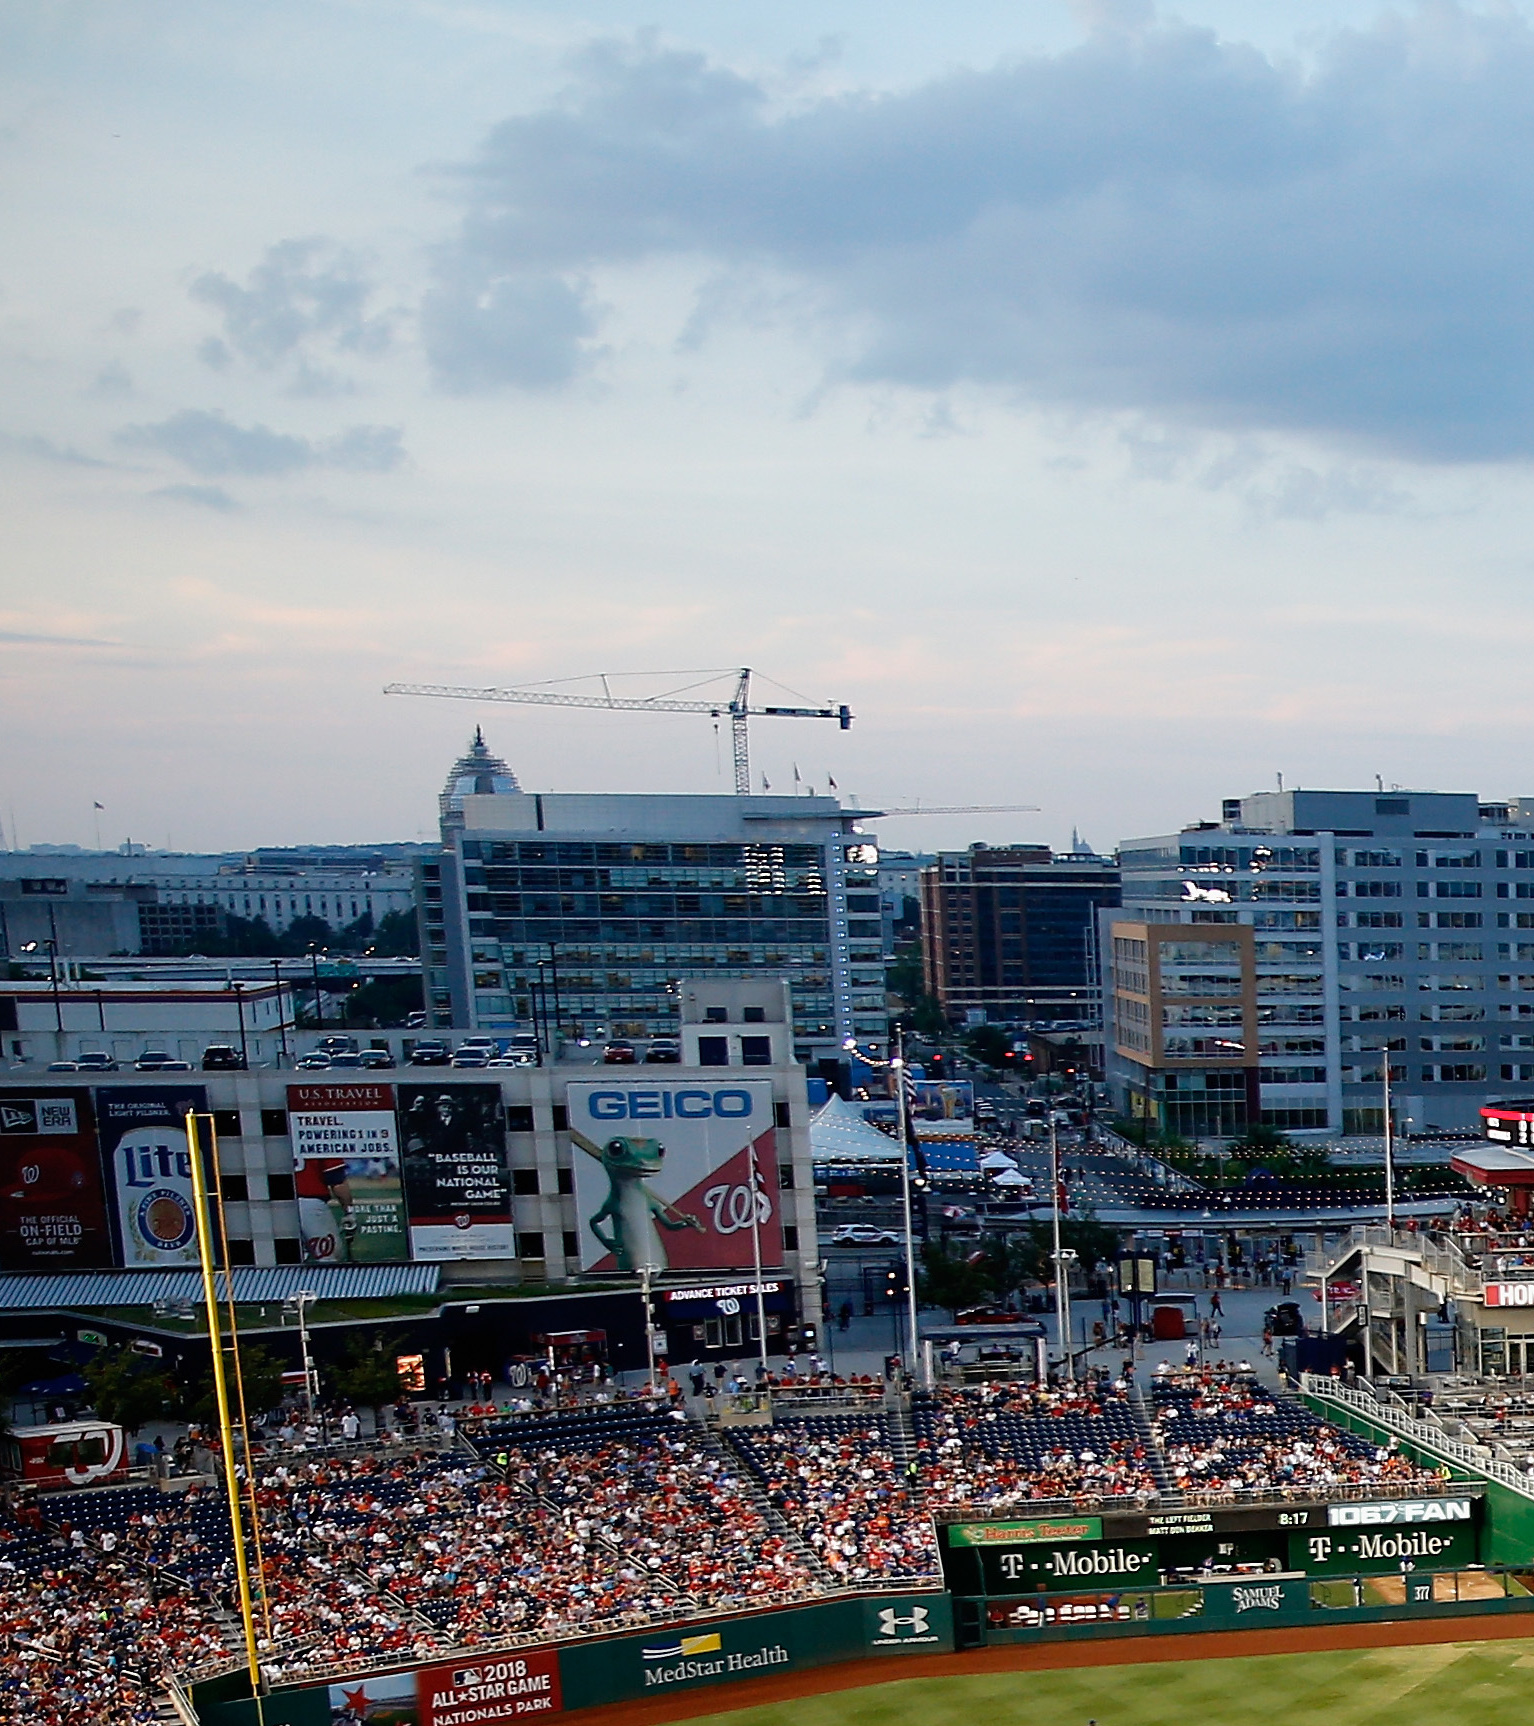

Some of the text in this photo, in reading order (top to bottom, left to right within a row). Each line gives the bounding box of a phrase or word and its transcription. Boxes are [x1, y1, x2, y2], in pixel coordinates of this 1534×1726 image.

[300, 1088, 382, 1099] U.S. TRAVEL
[589, 1090, 753, 1119] GEICO
[42, 1107, 70, 1115] NEW
[43, 1117, 71, 1126] ERA
[298, 1116, 344, 1126] TRAVEL.
[299, 1130, 377, 1140] POWERING IN
[301, 1143, 393, 1154] AMERICAN JOBS.
[428, 1153, 497, 1162] "BASEBALL
[123, 1145, 192, 1187] Lite
[457, 1166, 498, 1175] IS OUR
[437, 1178, 499, 1187] NATIONAL
[466, 1189, 507, 1198] GAME"
[348, 1205, 370, 1213] MORE
[41, 1215, 80, 1224] OFFICIAL
[20, 1224, 82, 1236] ON-FIELD
[25, 1238, 43, 1246] CAP
[671, 1286, 747, 1300] ADVANCE TICKET
[1405, 1501, 1471, 1522] FAN
[1278, 1512, 1309, 1525] 8:17
[1039, 1524, 1088, 1536] Teeter
[1233, 1585, 1285, 1601] SAMUEL
[1414, 1586, 1430, 1600] 377
[1236, 1597, 1280, 1613] ADAMS
[484, 1660, 526, 1682] 2018
[644, 1645, 789, 1686] MedStar Health
[507, 1675, 551, 1695] GAME
[433, 1697, 552, 1726] NATIONALS PARK
